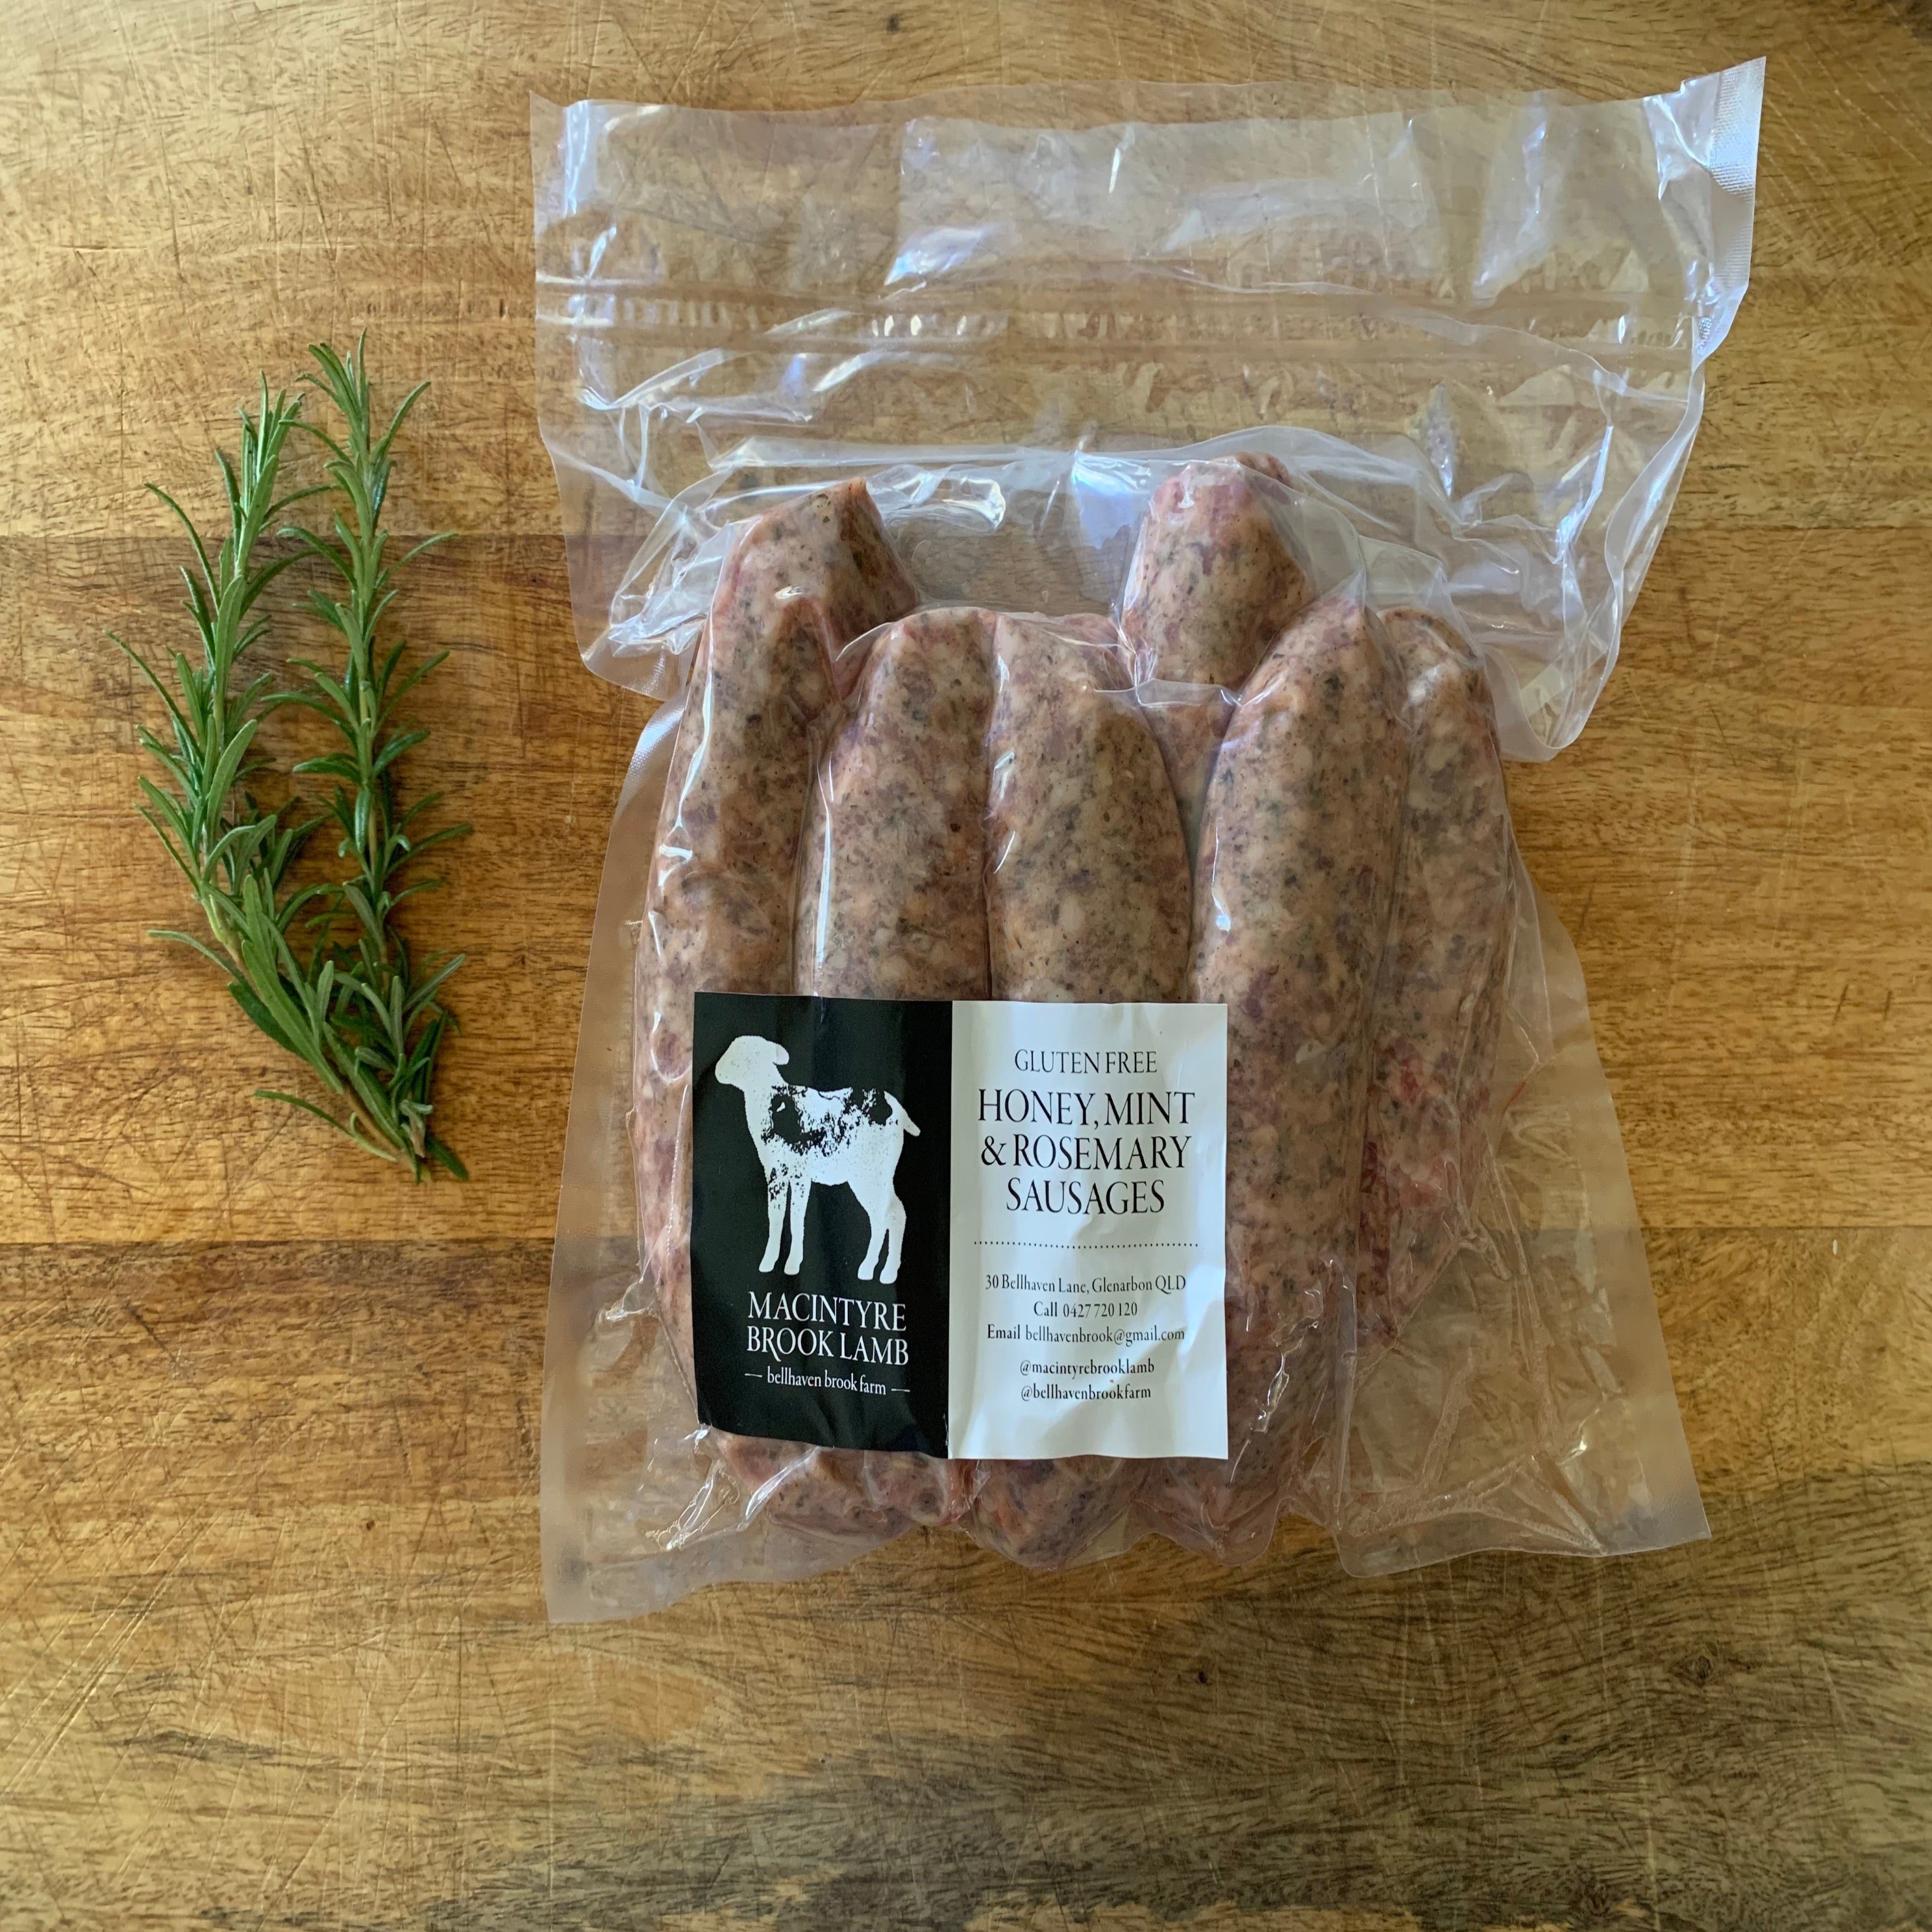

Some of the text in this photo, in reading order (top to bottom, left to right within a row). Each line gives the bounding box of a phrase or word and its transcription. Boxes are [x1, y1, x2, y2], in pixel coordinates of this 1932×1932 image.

[1015, 1049, 1157, 1073] GLUTEN FREE
[978, 1089, 1195, 1130] HONEY, MINT
[981, 1134, 1191, 1170] & ROSEMARY
[1006, 1178, 1165, 1215] SAUSAGES
[985, 1274, 1186, 1294] 30 Bellhaven Lane, Glenarbon QLD
[748, 1291, 906, 1331] MACINTYRE
[1034, 1301, 1058, 1317] Call
[1118, 1302, 1137, 1316] 120
[747, 1326, 909, 1365] BROOK LAMB
[987, 1324, 1184, 1346] Email bellhavenbrook@gmail.com
[767, 1366, 886, 1394] bellhaven brook farm
[1020, 1359, 1154, 1379] @macintyrebrooklamb
[1021, 1384, 1151, 1402] @bellhavenbrookfarm
